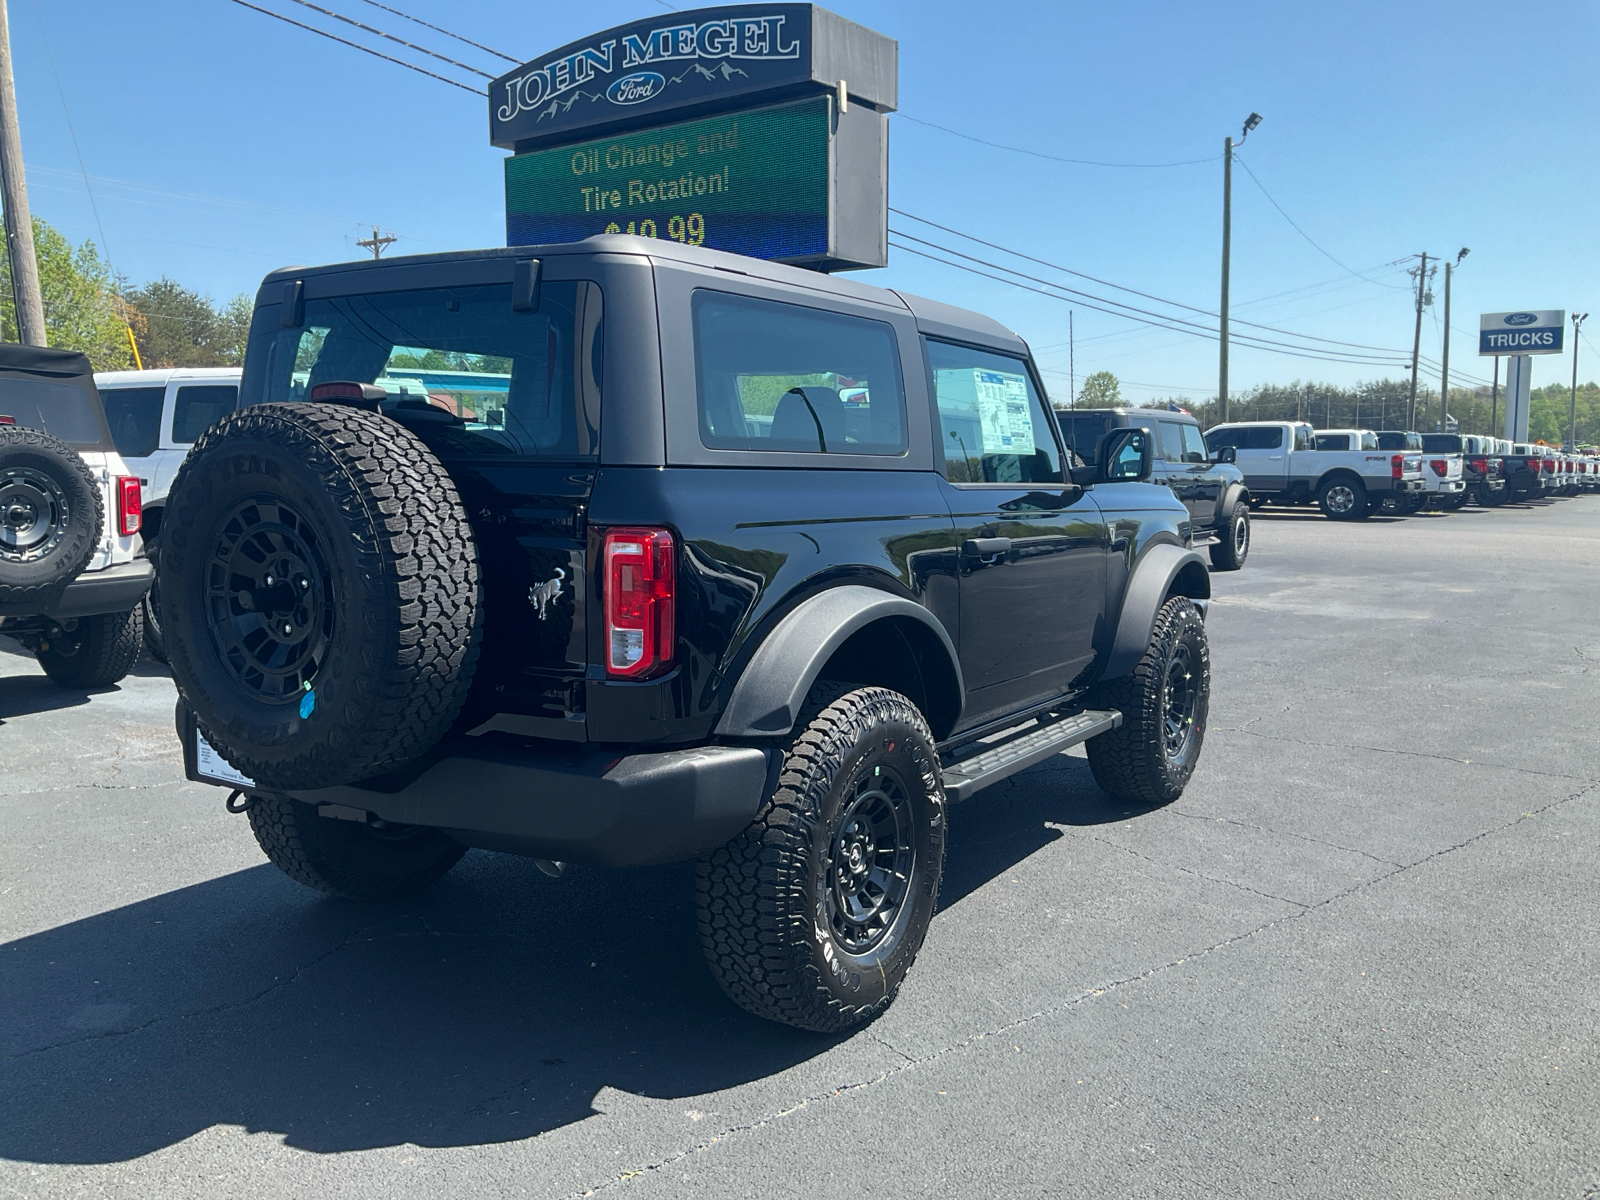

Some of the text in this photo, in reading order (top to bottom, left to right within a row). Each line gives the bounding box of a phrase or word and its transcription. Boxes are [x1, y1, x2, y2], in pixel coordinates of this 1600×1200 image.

[497, 14, 801, 123] JOHN MEGEL
[617, 77, 655, 101] Ford
[571, 122, 740, 176] Oil Change and
[580, 165, 731, 213] Tire Rotation!
[1510, 314, 1530, 324] Ford
[1487, 332, 1554, 347] TRUCKS
